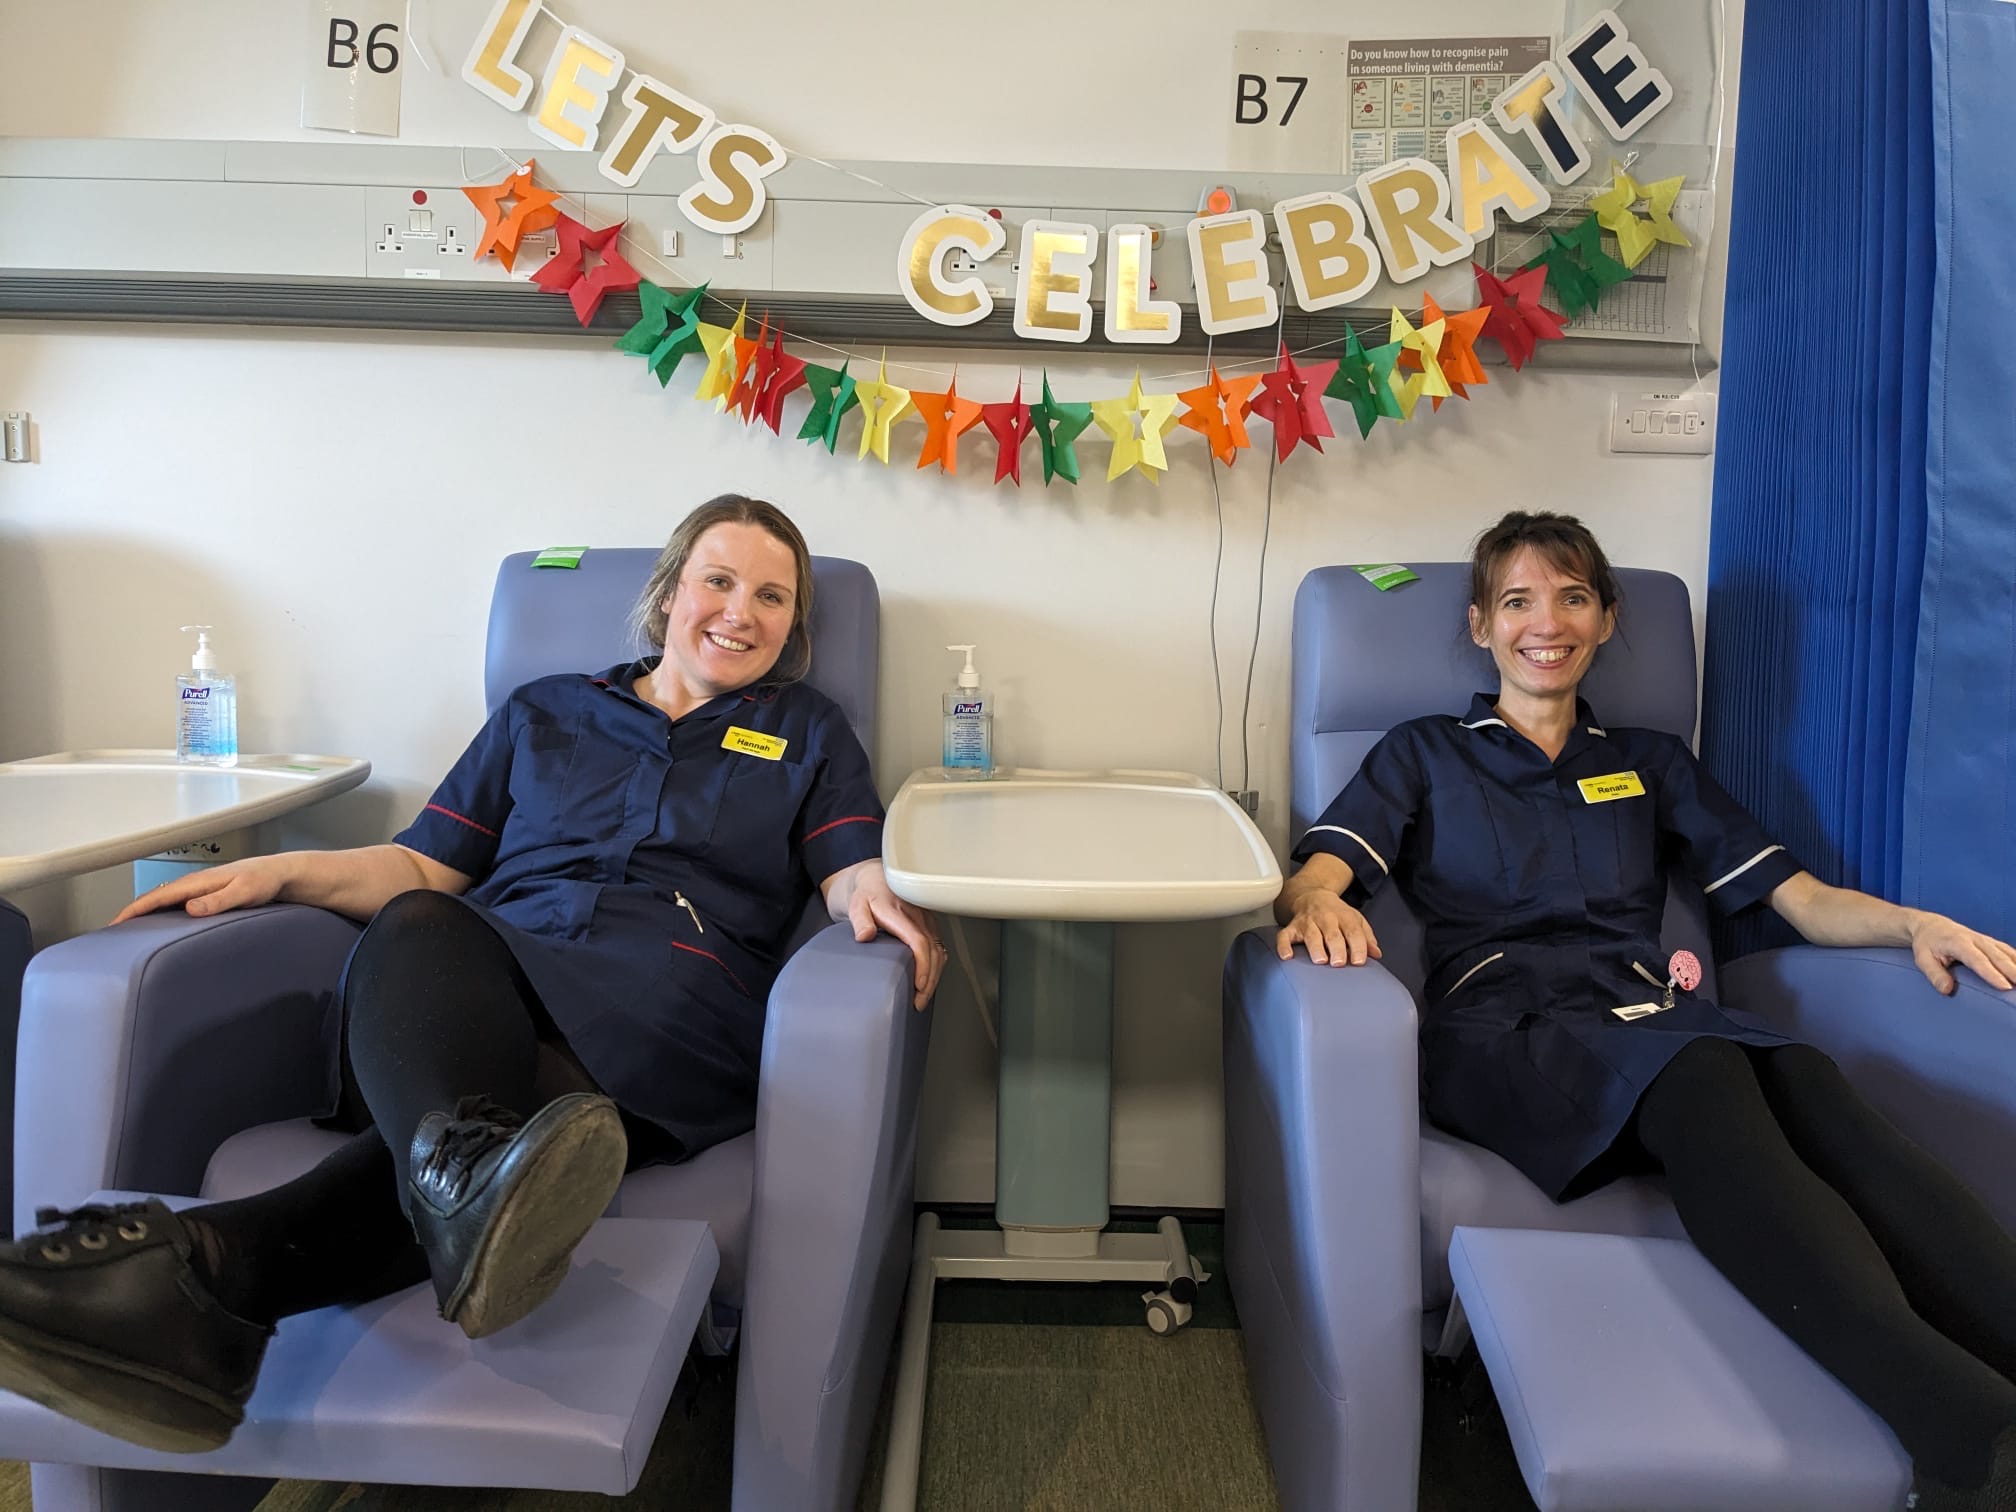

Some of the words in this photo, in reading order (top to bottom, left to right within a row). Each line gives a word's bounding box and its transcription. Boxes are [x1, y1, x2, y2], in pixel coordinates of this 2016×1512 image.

[328, 17, 400, 74] B6
[1350, 49, 1363, 60] Do
[1364, 50, 1381, 62] you
[1383, 48, 1408, 59] know
[1409, 47, 1430, 58] how
[1431, 48, 1441, 58] to
[1442, 47, 1487, 60] recognise
[1488, 45, 1509, 59] pain
[1350, 64, 1360, 74] in
[1361, 65, 1403, 75] someone
[1404, 63, 1431, 75] living
[1432, 62, 1453, 73] with
[1454, 61, 1504, 73] dementia?
[1235, 74, 1309, 126] B7
[473, 0, 772, 223] LETS
[909, 22, 1662, 331] CELEBRATE
[184, 688, 208, 699] Purell
[957, 704, 980, 713] Purell
[737, 738, 770, 752] Hannah
[1597, 784, 1629, 794] Renata
